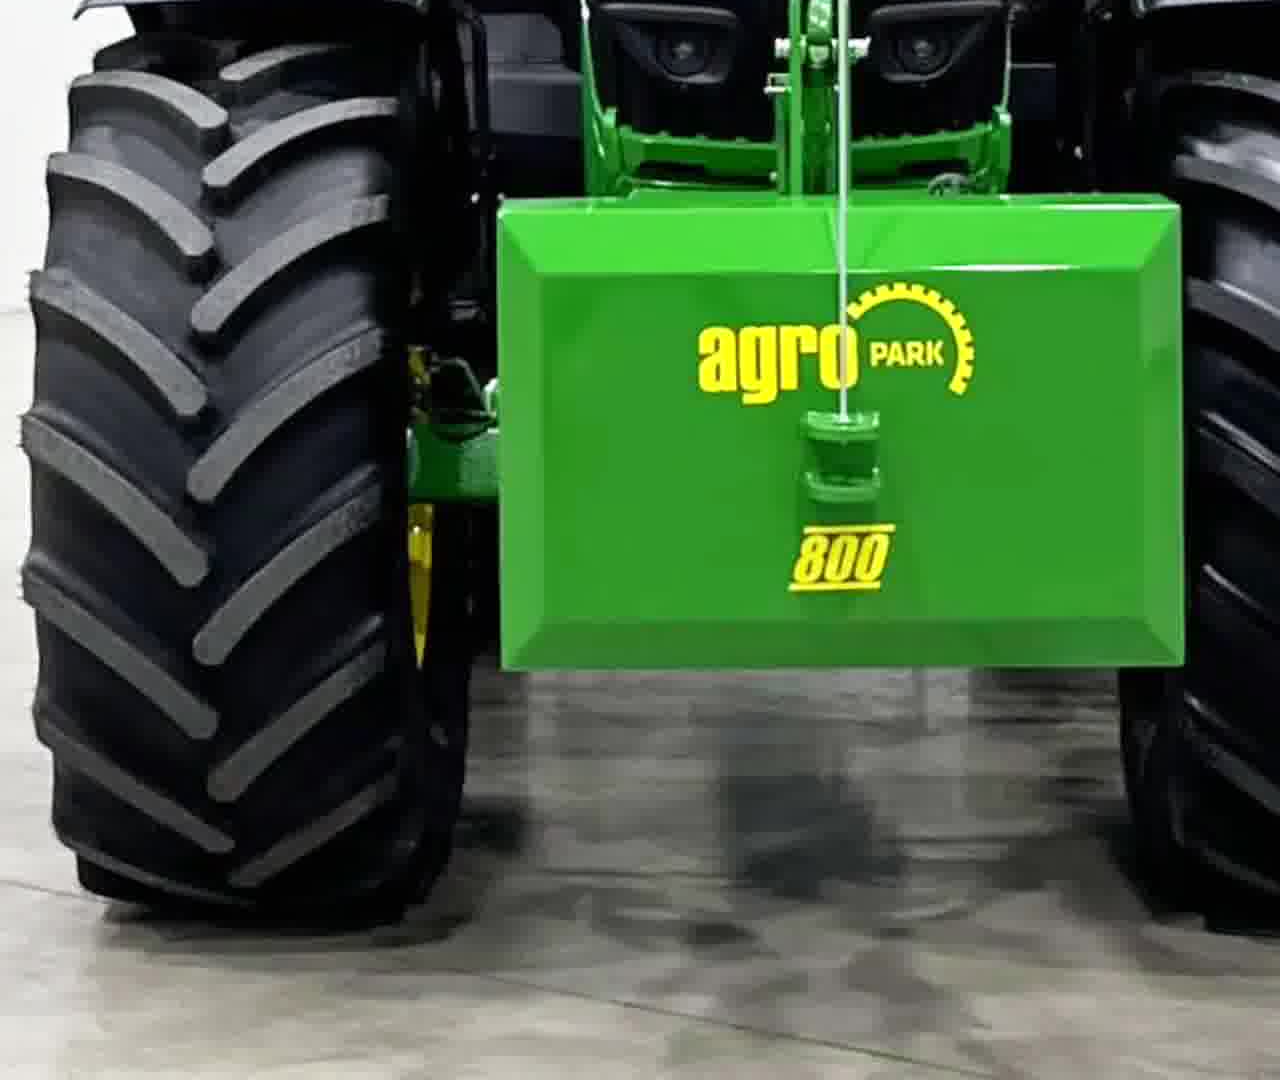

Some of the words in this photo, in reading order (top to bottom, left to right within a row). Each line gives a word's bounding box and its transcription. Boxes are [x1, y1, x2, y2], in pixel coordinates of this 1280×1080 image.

[698, 324, 859, 404] agro
[869, 340, 945, 368] PARK
[793, 533, 891, 584] 800
